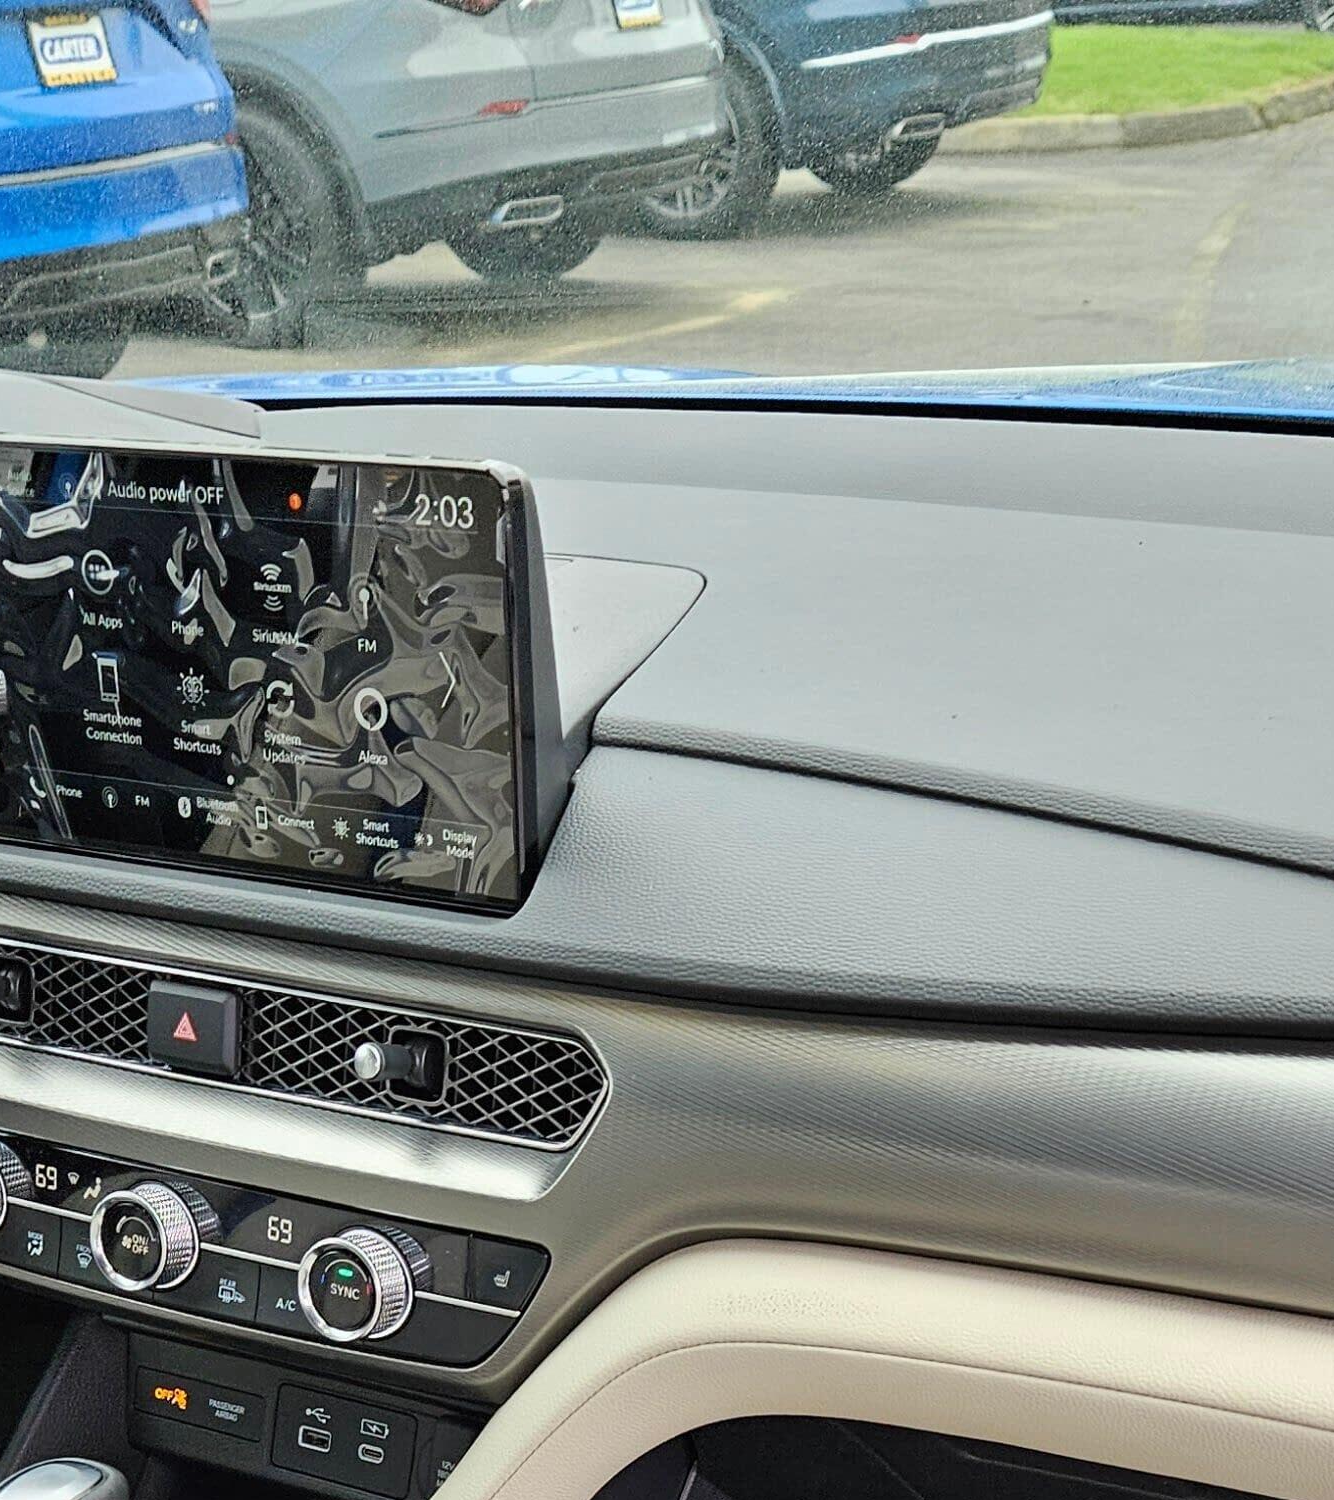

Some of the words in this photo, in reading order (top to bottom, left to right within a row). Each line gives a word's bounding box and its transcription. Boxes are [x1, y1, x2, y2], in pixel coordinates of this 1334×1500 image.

[42, 37, 98, 58] CARTER
[107, 482, 145, 499] Audio
[149, 489, 191, 504] power
[195, 487, 224, 505] OFF
[415, 493, 475, 529] 2:03
[83, 613, 97, 626] All
[98, 615, 123, 629] Apps
[171, 621, 204, 636] Phone
[357, 638, 377, 653] FM
[83, 709, 142, 728] Smartphone
[181, 720, 211, 736] Smart
[86, 727, 143, 746] Connection
[264, 730, 302, 747] System
[174, 738, 222, 756] Shortcuts
[263, 749, 306, 765] Updates
[359, 750, 388, 766] Alexa
[56, 785, 83, 799] Phone
[135, 796, 150, 807] FM
[206, 813, 231, 827] Audio
[278, 815, 315, 830] Connect
[363, 819, 390, 834] Smart
[355, 833, 399, 850] Shortcuts
[443, 829, 477, 846] Display
[446, 845, 475, 860] Mode
[35, 1164, 58, 1191] 69
[27, 1230, 43, 1242] MODE
[267, 1215, 293, 1244] 69
[131, 1244, 149, 1255] OFF
[219, 1277, 237, 1288] REAR
[330, 1282, 360, 1301] SYNC
[275, 1297, 297, 1312] A/C
[154, 1387, 174, 1401] OFF
[208, 1398, 245, 1415] PASSENGER
[214, 1410, 239, 1422] AIRBAG
